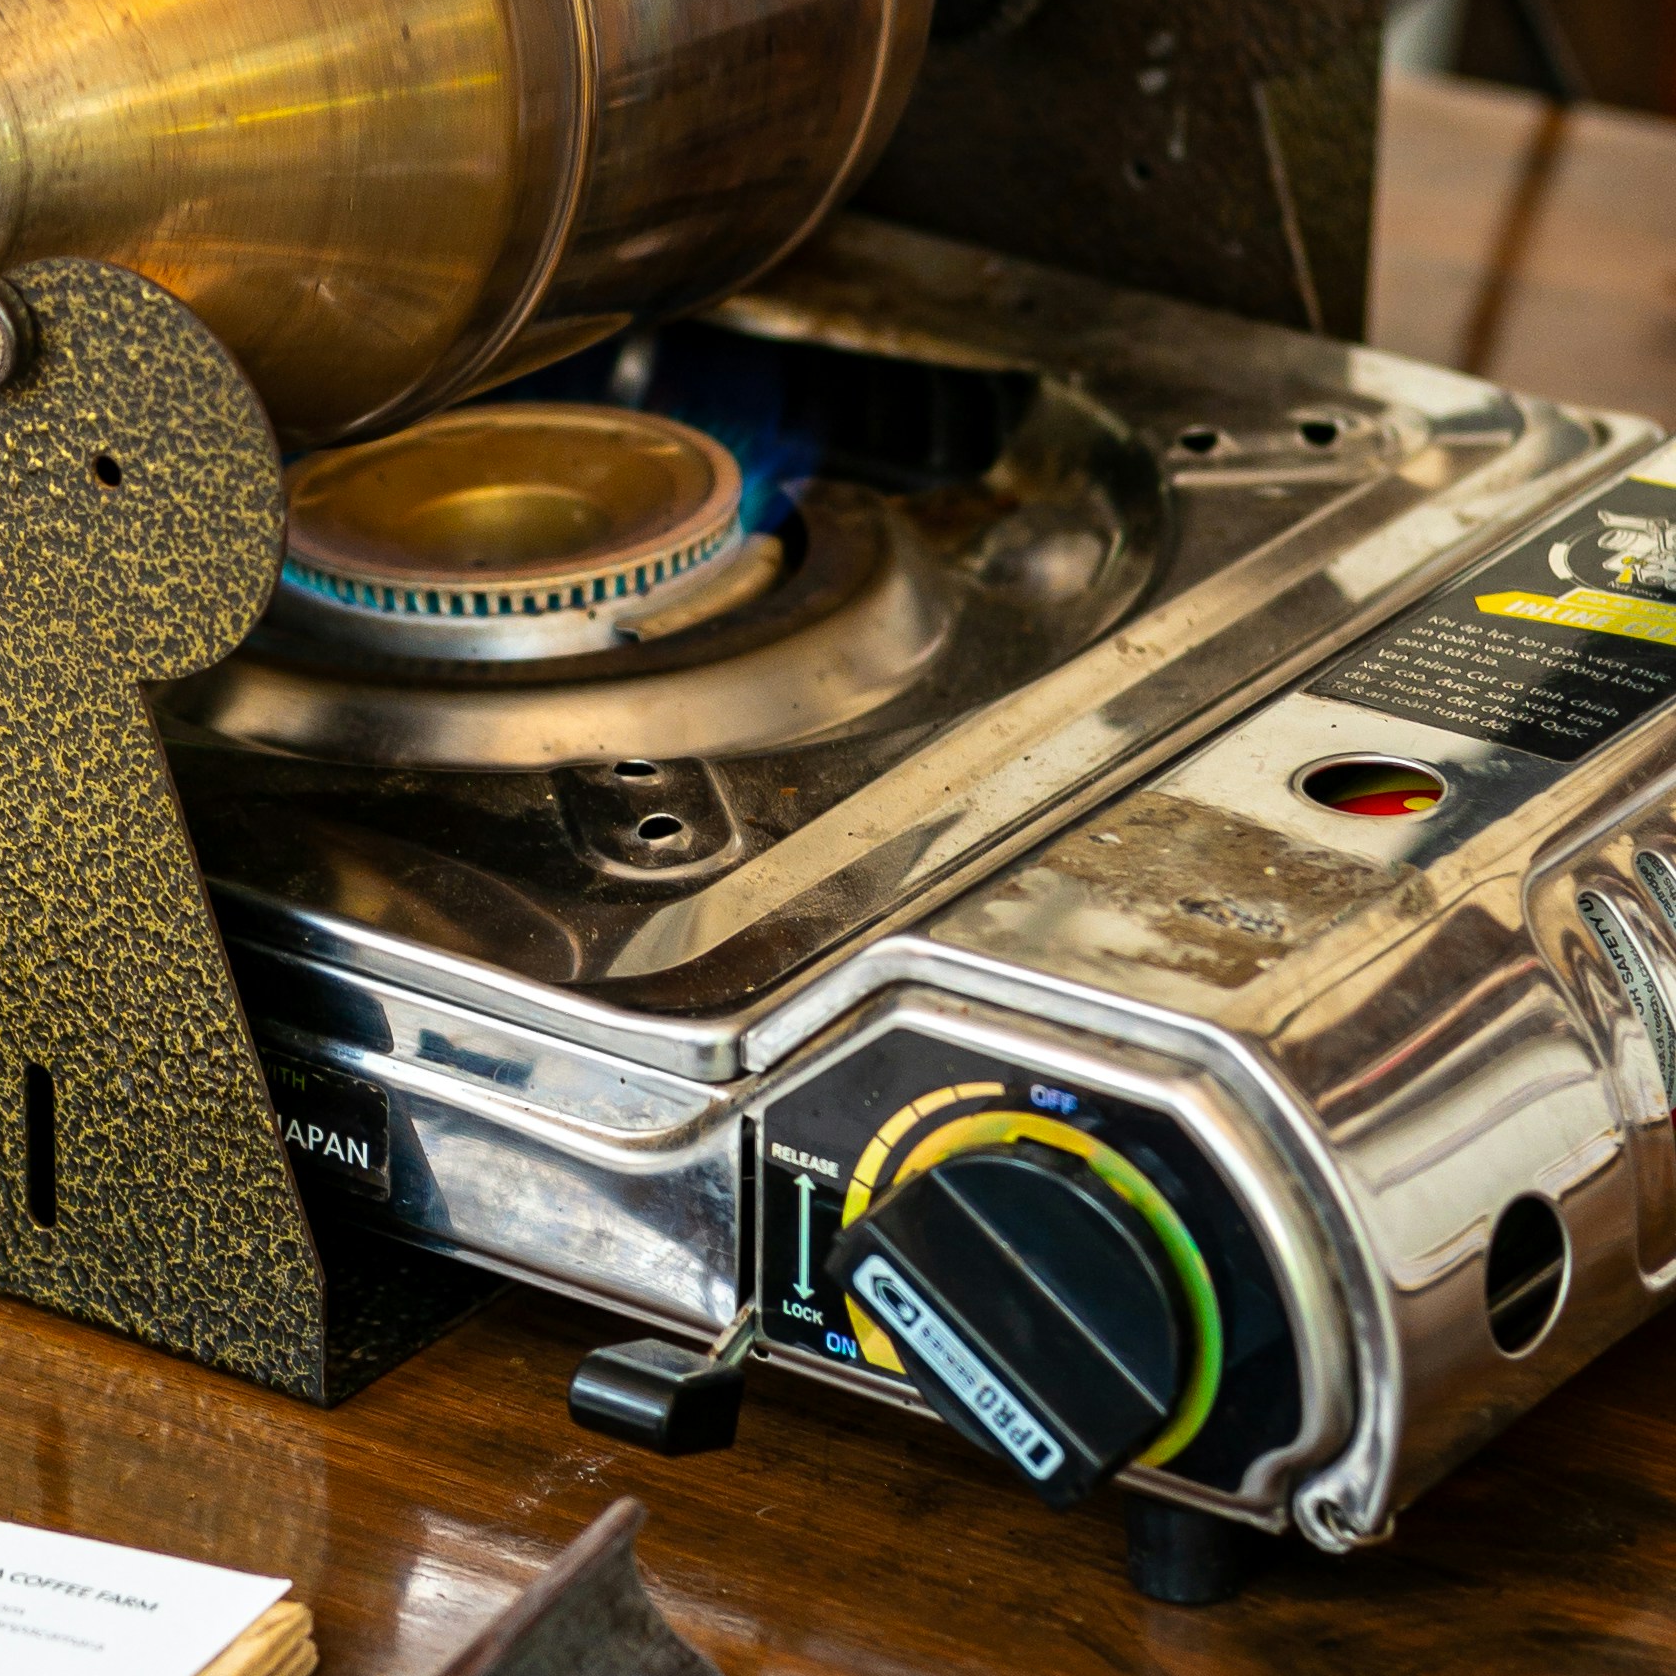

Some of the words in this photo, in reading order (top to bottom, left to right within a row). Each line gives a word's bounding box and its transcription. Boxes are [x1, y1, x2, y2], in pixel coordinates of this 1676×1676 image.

[1623, 621, 1676, 643] CU
[1589, 909, 1635, 984] SAFETY
[1028, 1082, 1079, 1115] OFF
[770, 1142, 841, 1181] RELEASE
[782, 1299, 824, 1326] LOCK
[826, 1330, 858, 1360] ON
[975, 1384, 1033, 1449] PRO
[9, 1570, 94, 1599] COFFEE
[94, 1588, 161, 1614] FARM
